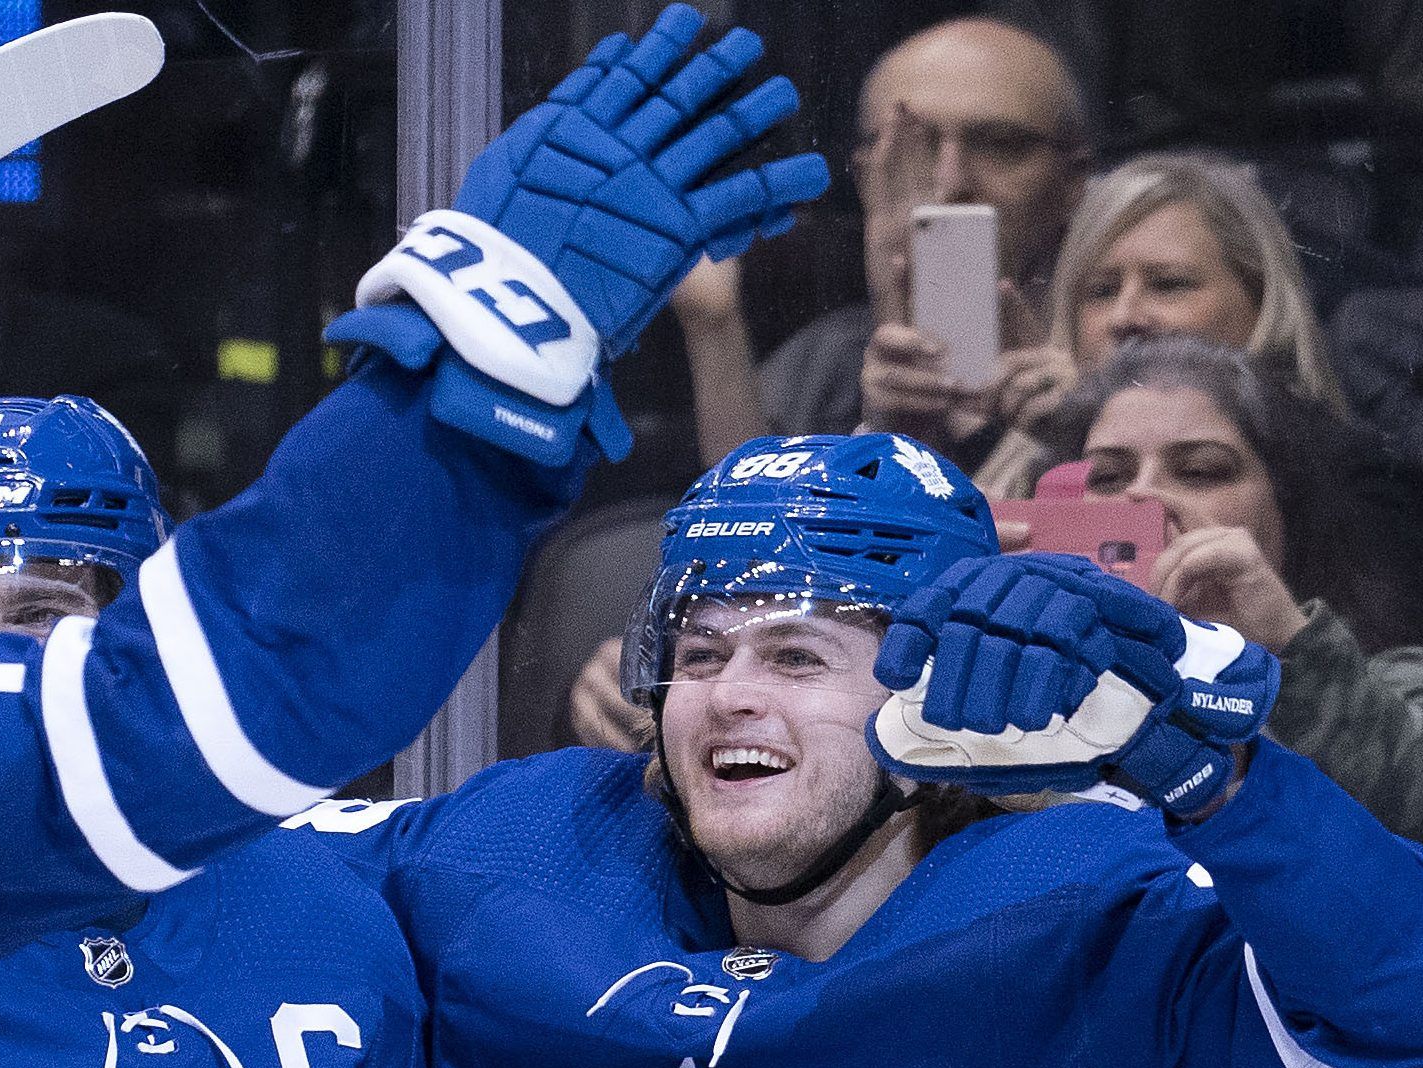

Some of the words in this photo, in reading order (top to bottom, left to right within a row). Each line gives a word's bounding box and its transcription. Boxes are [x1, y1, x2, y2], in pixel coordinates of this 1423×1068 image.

[401, 226, 572, 357] CC
[686, 521, 775, 538] BAUER
[1191, 691, 1255, 715] NYLANDER
[1164, 763, 1214, 803] BAUER
